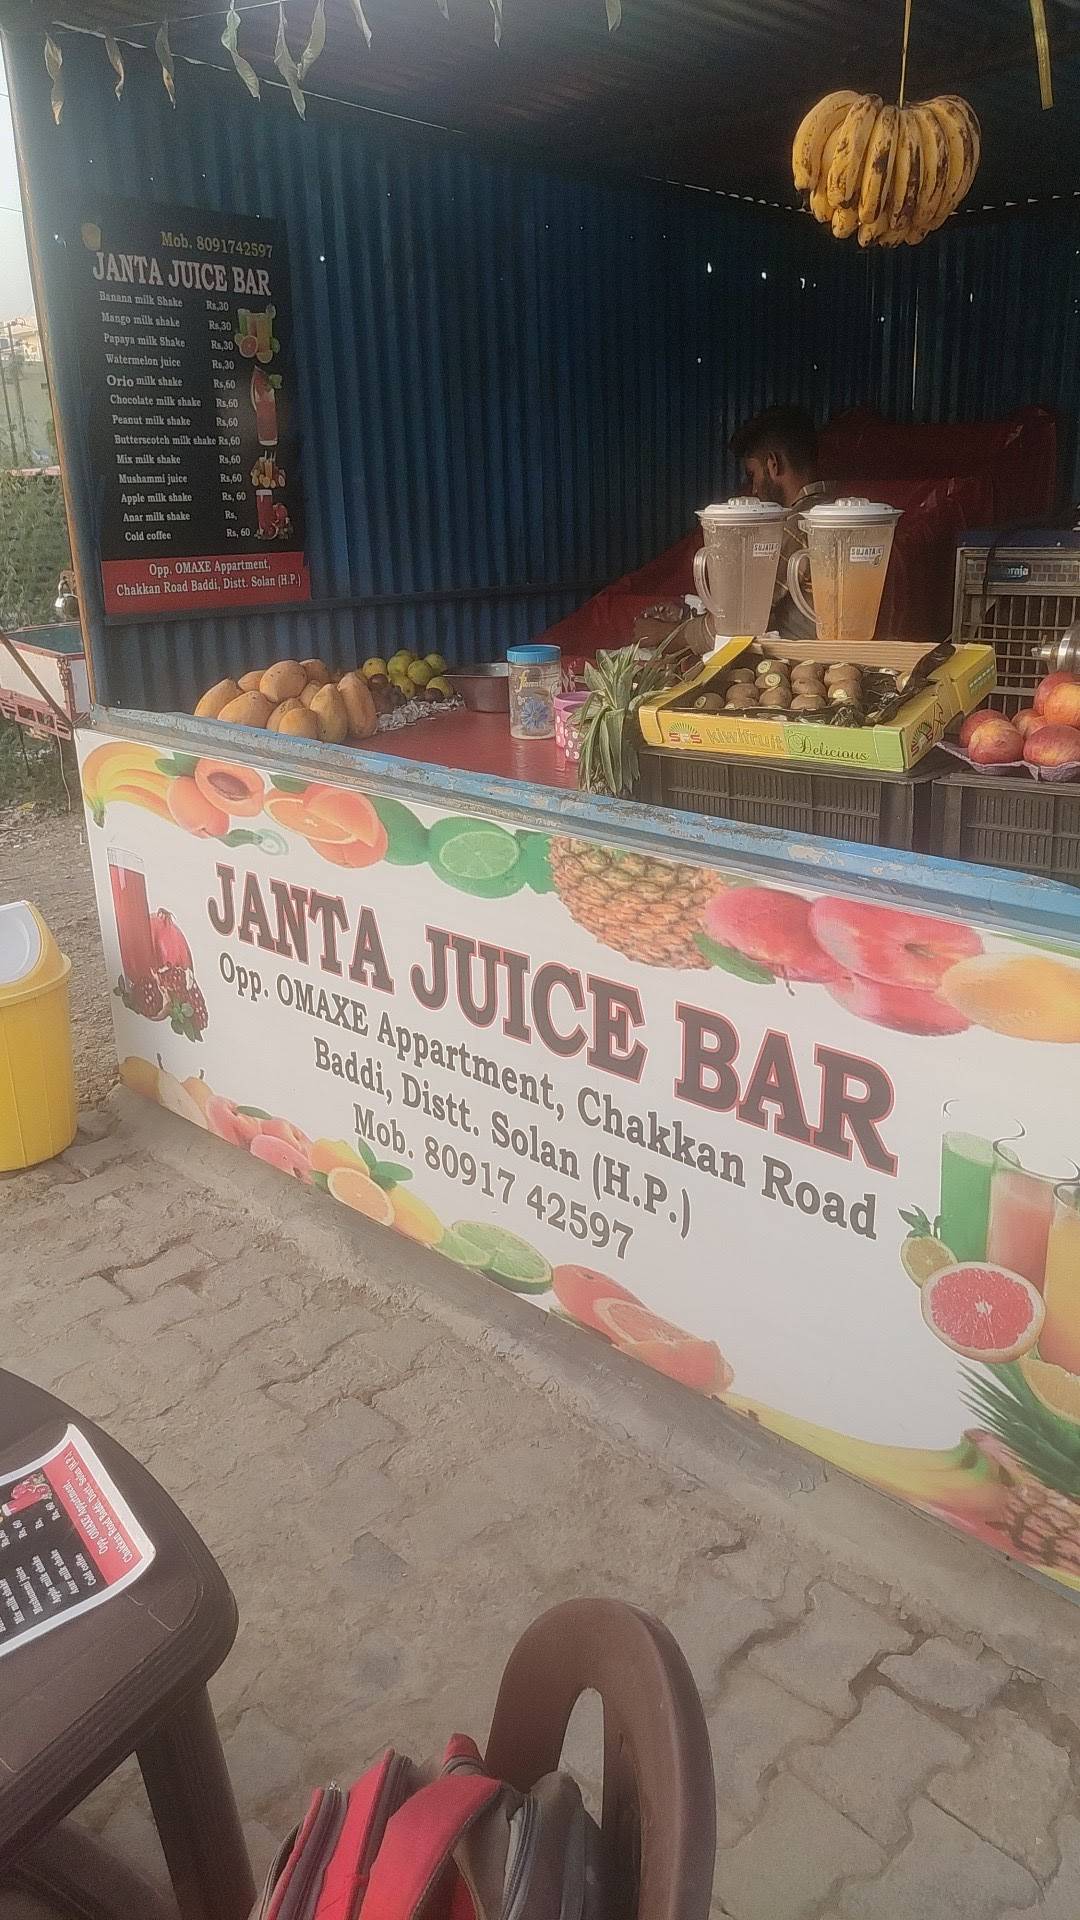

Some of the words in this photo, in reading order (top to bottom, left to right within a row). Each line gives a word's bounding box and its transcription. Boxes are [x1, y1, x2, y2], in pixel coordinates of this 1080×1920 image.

[160, 232, 193, 249] Mob.
[197, 236, 273, 259] 8091742597
[93, 252, 164, 286] JANTA
[168, 260, 227, 292] JUICE
[232, 266, 272, 296] BAR
[99, 291, 132, 304] Banana
[135, 295, 155, 306] milk
[157, 296, 183, 308] Shake
[102, 312, 131, 325] Mango
[134, 315, 153, 326] milk
[156, 317, 180, 328] shake
[104, 333, 135, 347] Papaya
[137, 336, 157, 347] milk
[159, 337, 185, 348] Shake
[106, 354, 158, 366] Watermelon
[160, 357, 181, 368] juice
[107, 375, 134, 387] Orio
[137, 376, 156, 386] milk
[158, 377, 183, 387] shake
[110, 395, 153, 406] Chocolate
[156, 397, 175, 407] milk
[178, 397, 200, 407] shake
[112, 415, 142, 425] Peanut
[145, 416, 165, 425] milk
[167, 416, 191, 426] shake
[115, 435, 170, 445] Butterscotch
[172, 436, 191, 445] milk
[193, 436, 216, 445] shake
[116, 455, 133, 464] Mix
[135, 455, 155, 464] milk
[157, 454, 181, 464] shake
[119, 474, 165, 484] Mushammi
[167, 473, 187, 485] juice
[121, 493, 145, 505] Apple
[148, 493, 166, 502] milk
[169, 493, 192, 502] shake
[236, 492, 246, 501] 60
[123, 512, 143, 522] Anar
[146, 512, 164, 521] milk
[167, 511, 190, 521] shake
[125, 531, 144, 541] Cold
[146, 530, 171, 540] coffee
[241, 528, 250, 537] 60
[851, 547, 876, 555] SUJATA
[149, 564, 172, 578] Opp.
[175, 561, 211, 574] OMAXE
[214, 559, 271, 573] Appartment,
[116, 583, 160, 597] Chakkan
[164, 581, 188, 593] Road
[191, 579, 221, 592] Baddi,
[223, 576, 249, 589] Distt.
[251, 575, 275, 587] Solan
[278, 574, 301, 587] (H.P.)
[788, 729, 869, 761] Delicious
[207, 862, 395, 996] JANTA
[409, 924, 649, 1083] JUICE
[672, 1001, 900, 1177] BAR
[219, 951, 270, 1002] Opp.
[275, 973, 370, 1036] OMAXE
[377, 1010, 564, 1122] Appartment,
[577, 1087, 745, 1187] Chakkan
[761, 1155, 877, 1239] Road
[313, 1036, 394, 1102] Baddi,
[401, 1072, 481, 1138] Distt.
[490, 1115, 580, 1181] Solan
[592, 1153, 692, 1239] (H.P.)
[353, 1103, 414, 1161] Mob.
[424, 1135, 515, 1205] 80917
[525, 1184, 635, 1259] 42597
